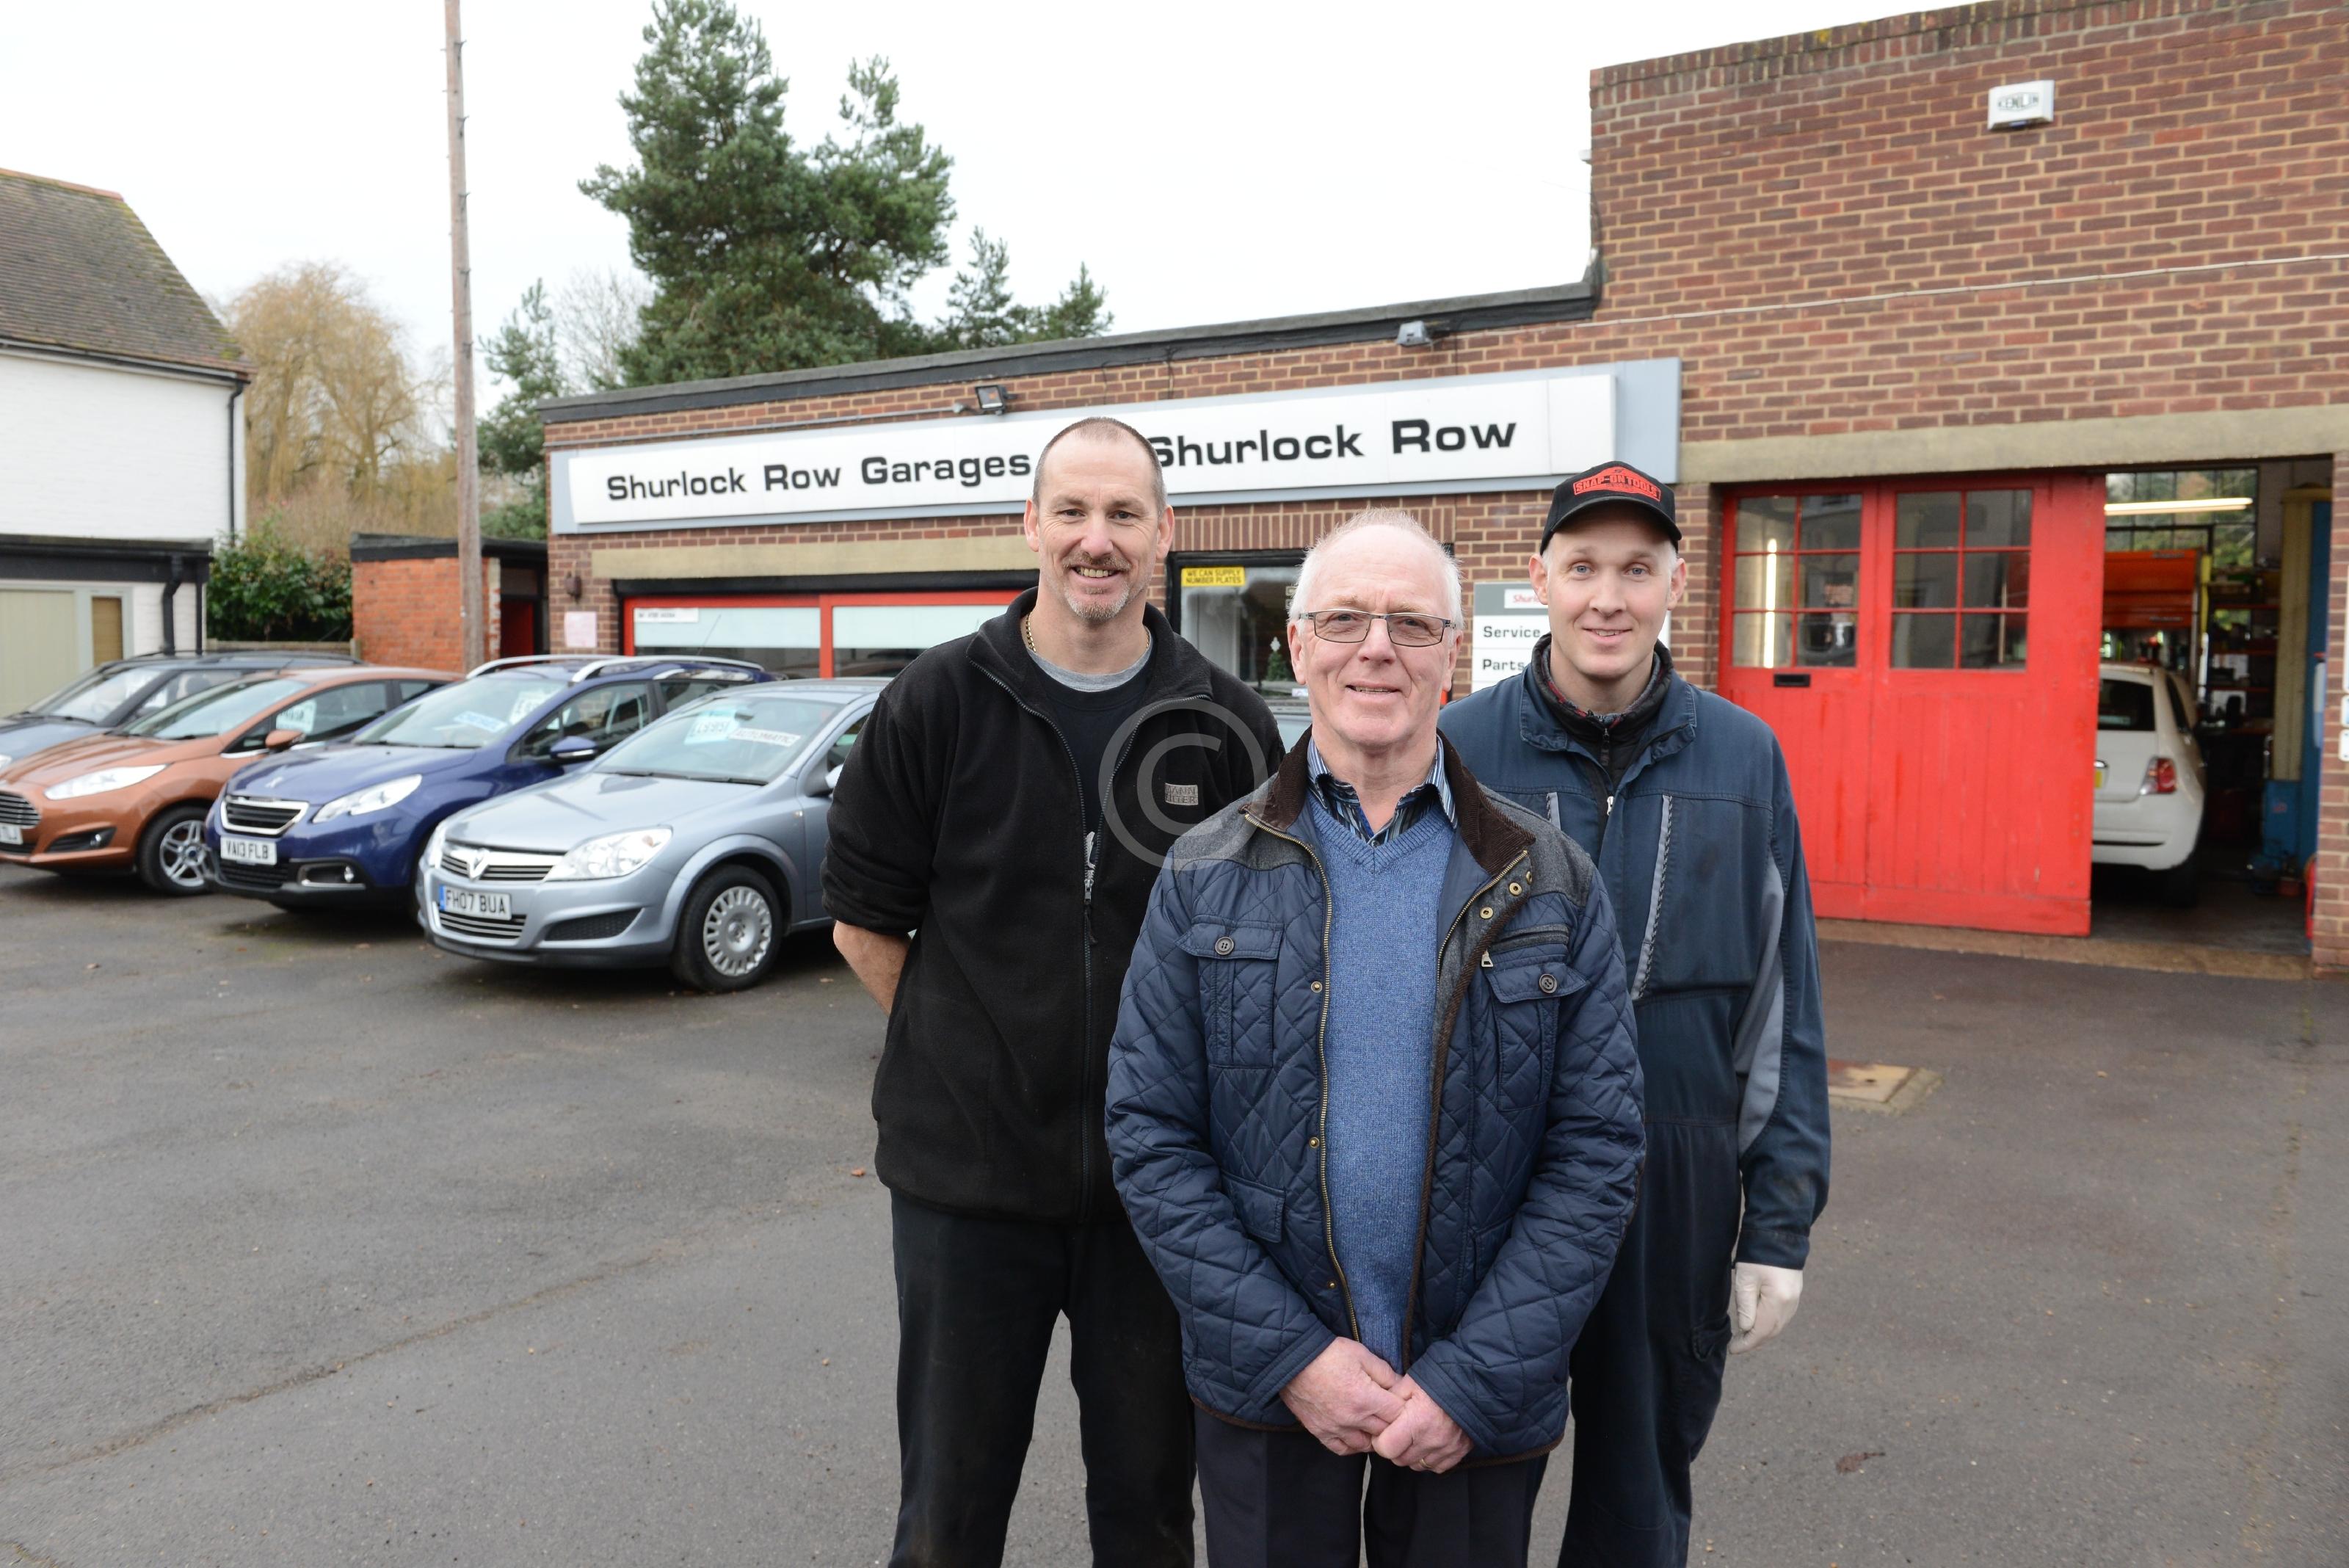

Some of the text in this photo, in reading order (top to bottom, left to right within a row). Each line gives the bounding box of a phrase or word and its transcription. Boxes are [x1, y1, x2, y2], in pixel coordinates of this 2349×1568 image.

[607, 418, 1517, 501] Shurlock Row Garages Shurlock Row
[1575, 475, 1658, 497] SNAP-ON TOOLS
[1215, 568, 1241, 576] SUPPLY
[1484, 625, 1541, 638] Service
[1483, 658, 1525, 671] Parts
[248, 843, 269, 859] FLB
[446, 889, 506, 914] FH07 BUA
